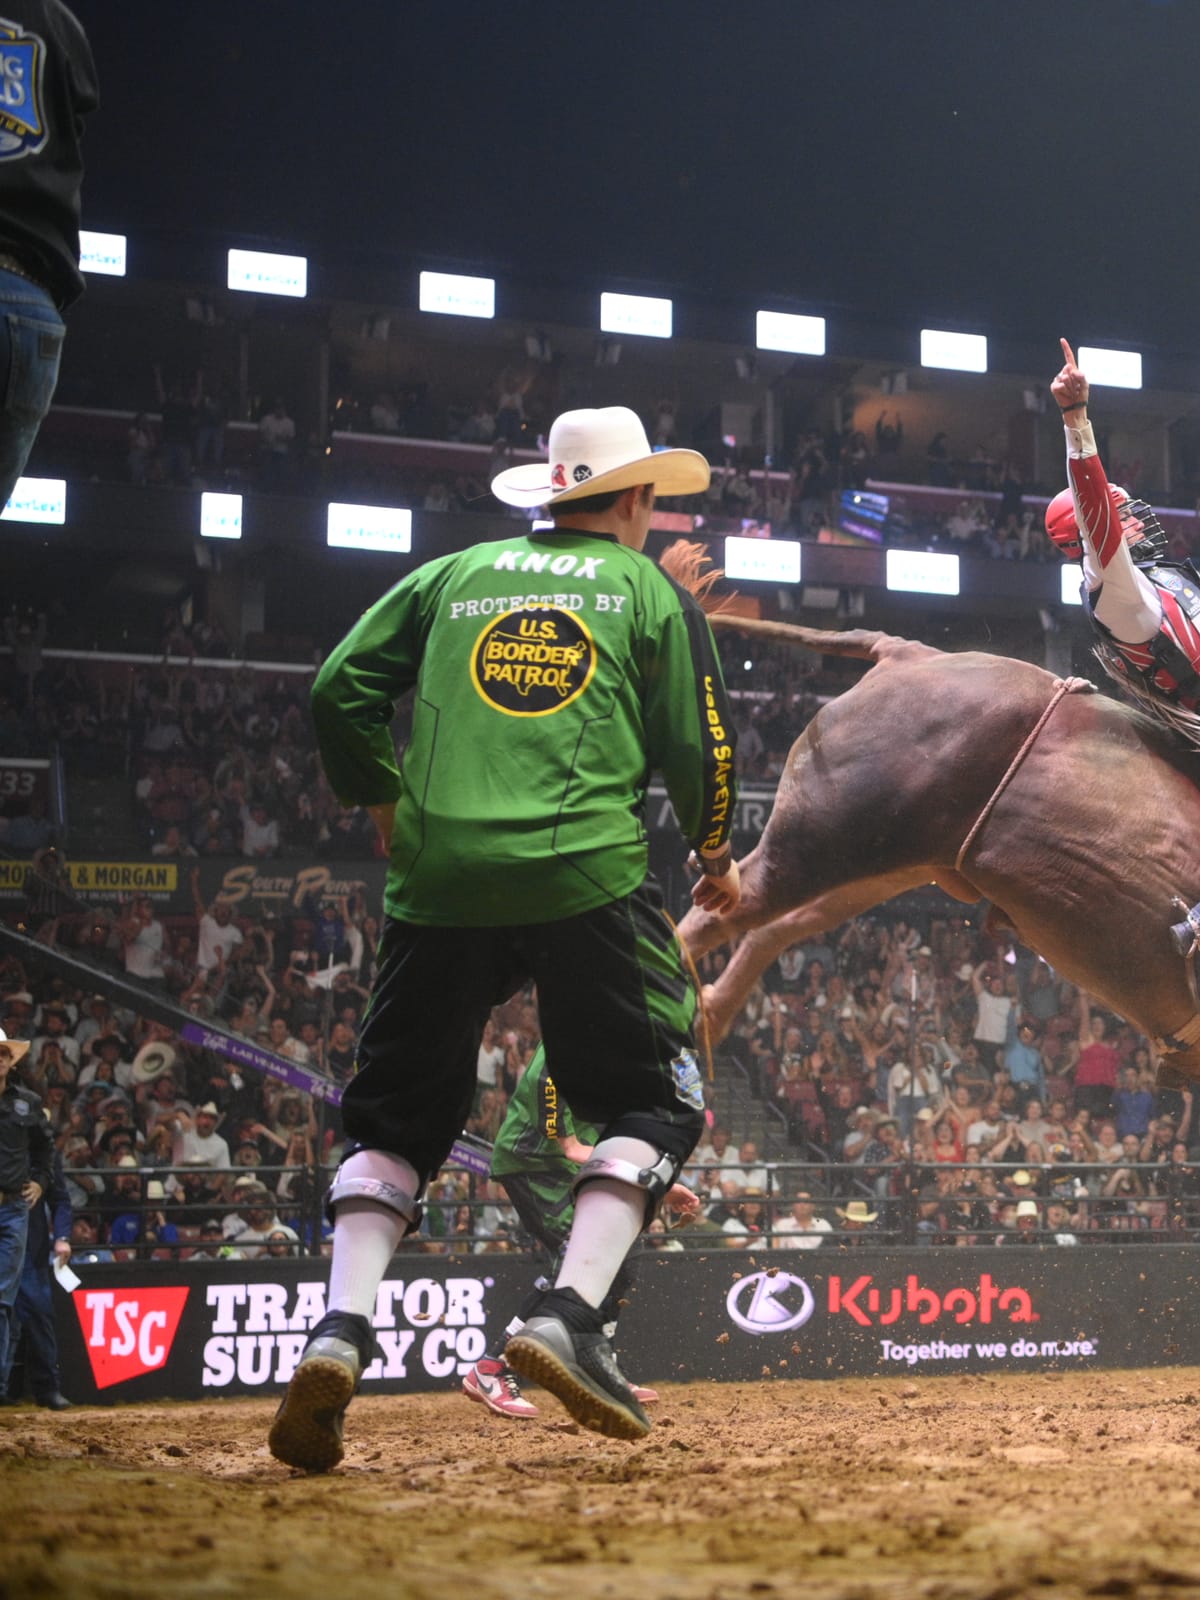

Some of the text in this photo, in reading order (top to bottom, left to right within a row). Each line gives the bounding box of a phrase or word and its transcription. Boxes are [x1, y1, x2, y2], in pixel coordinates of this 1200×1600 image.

[494, 551, 605, 579] KNOX
[449, 593, 626, 619] PROTECTED BY
[520, 619, 558, 639] U.S.
[487, 641, 580, 666] BORDER
[483, 663, 572, 688] PATROL
[704, 675, 726, 741] USBP
[712, 745, 732, 822] SAFETY
[95, 867, 168, 886] MORGAN
[206, 1278, 486, 1333] TRATOR
[828, 1274, 1033, 1325] Kubota
[86, 1292, 166, 1366] TSC
[202, 1331, 415, 1386] SUPY
[880, 1340, 970, 1364] Together
[975, 1342, 1007, 1357] we
[1011, 1338, 1038, 1356] do
